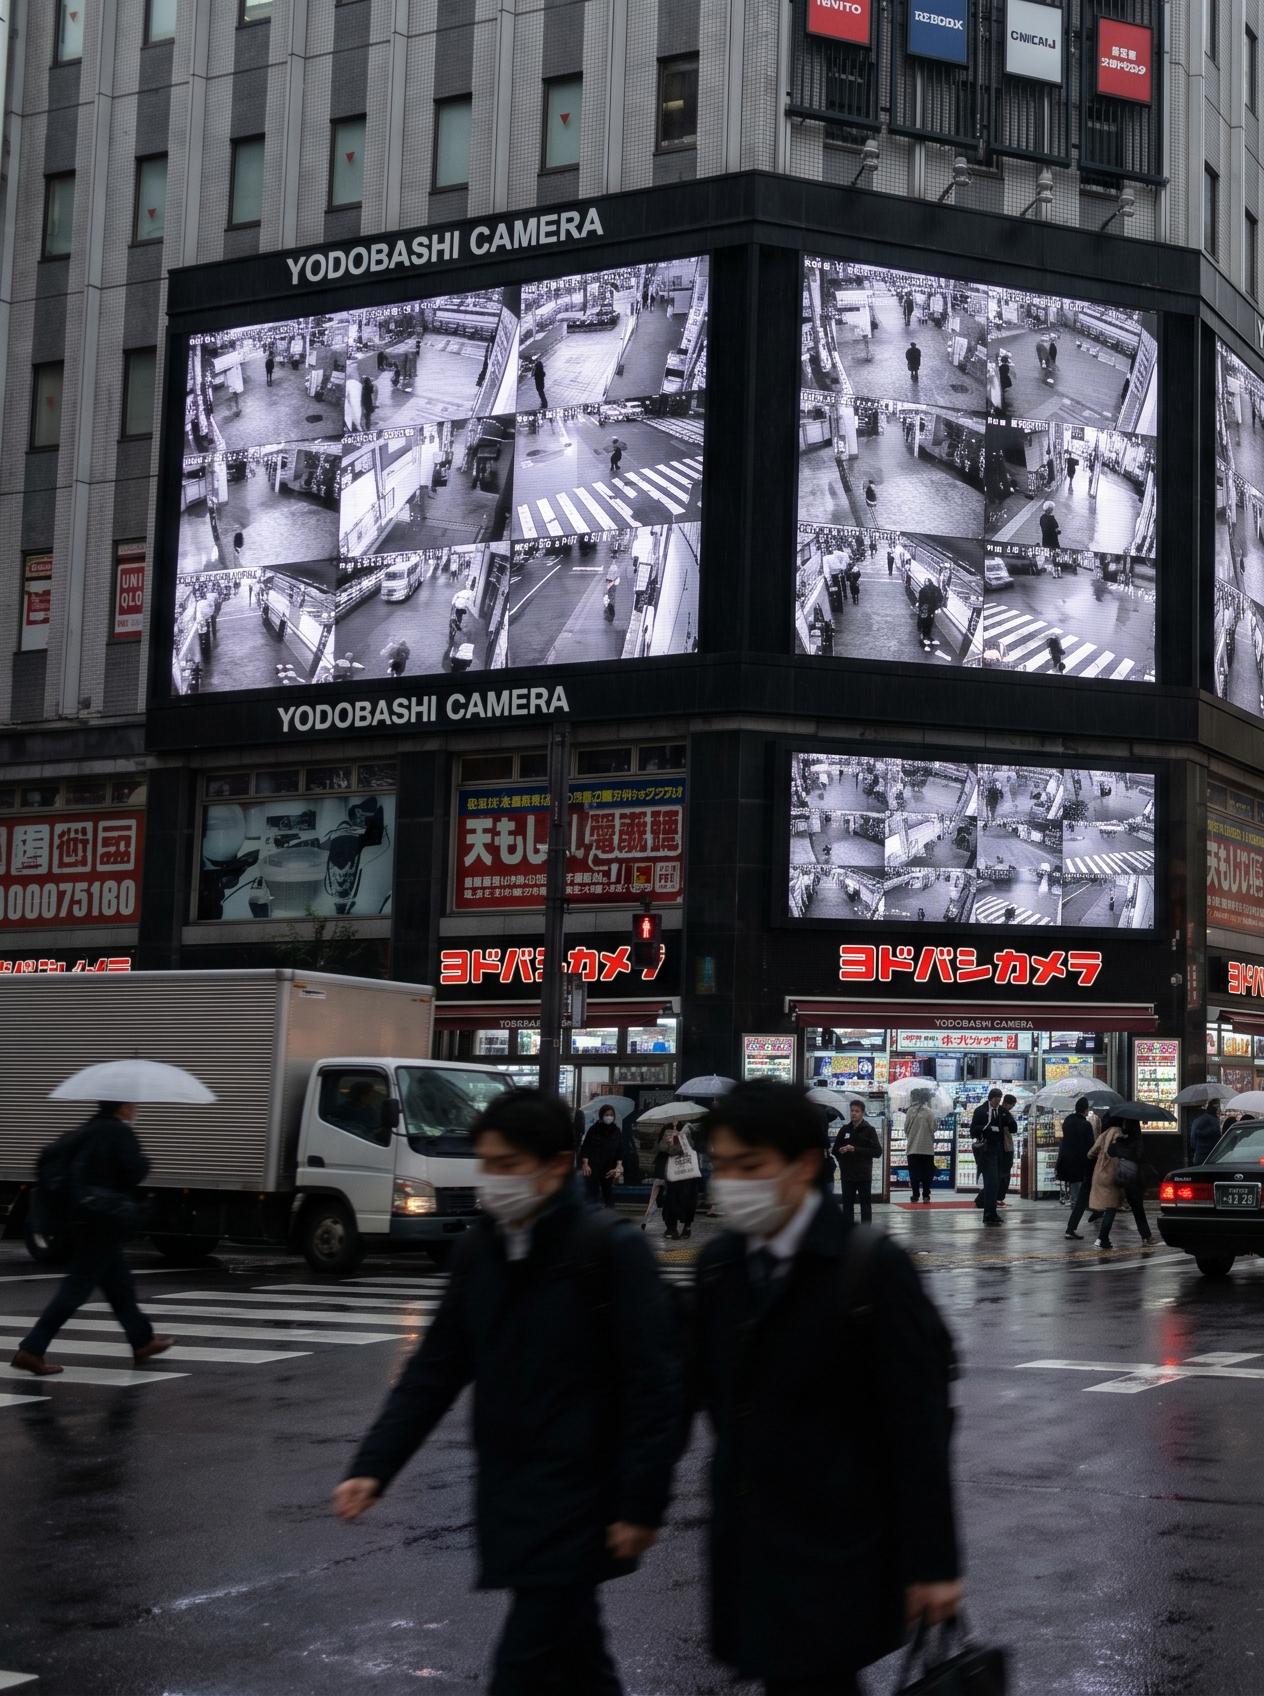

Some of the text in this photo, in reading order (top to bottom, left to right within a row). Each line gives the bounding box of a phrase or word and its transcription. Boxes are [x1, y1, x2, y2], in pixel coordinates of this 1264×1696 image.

[286, 207, 604, 285] YODOBASHI CAMERA
[121, 573, 142, 588] UNI
[121, 591, 143, 608] QLO
[278, 686, 570, 733] YODOBASHI CAMERA
[839, 944, 1103, 986] ヨドバシカメラ
[993, 1020, 1034, 1029] CAMERA
